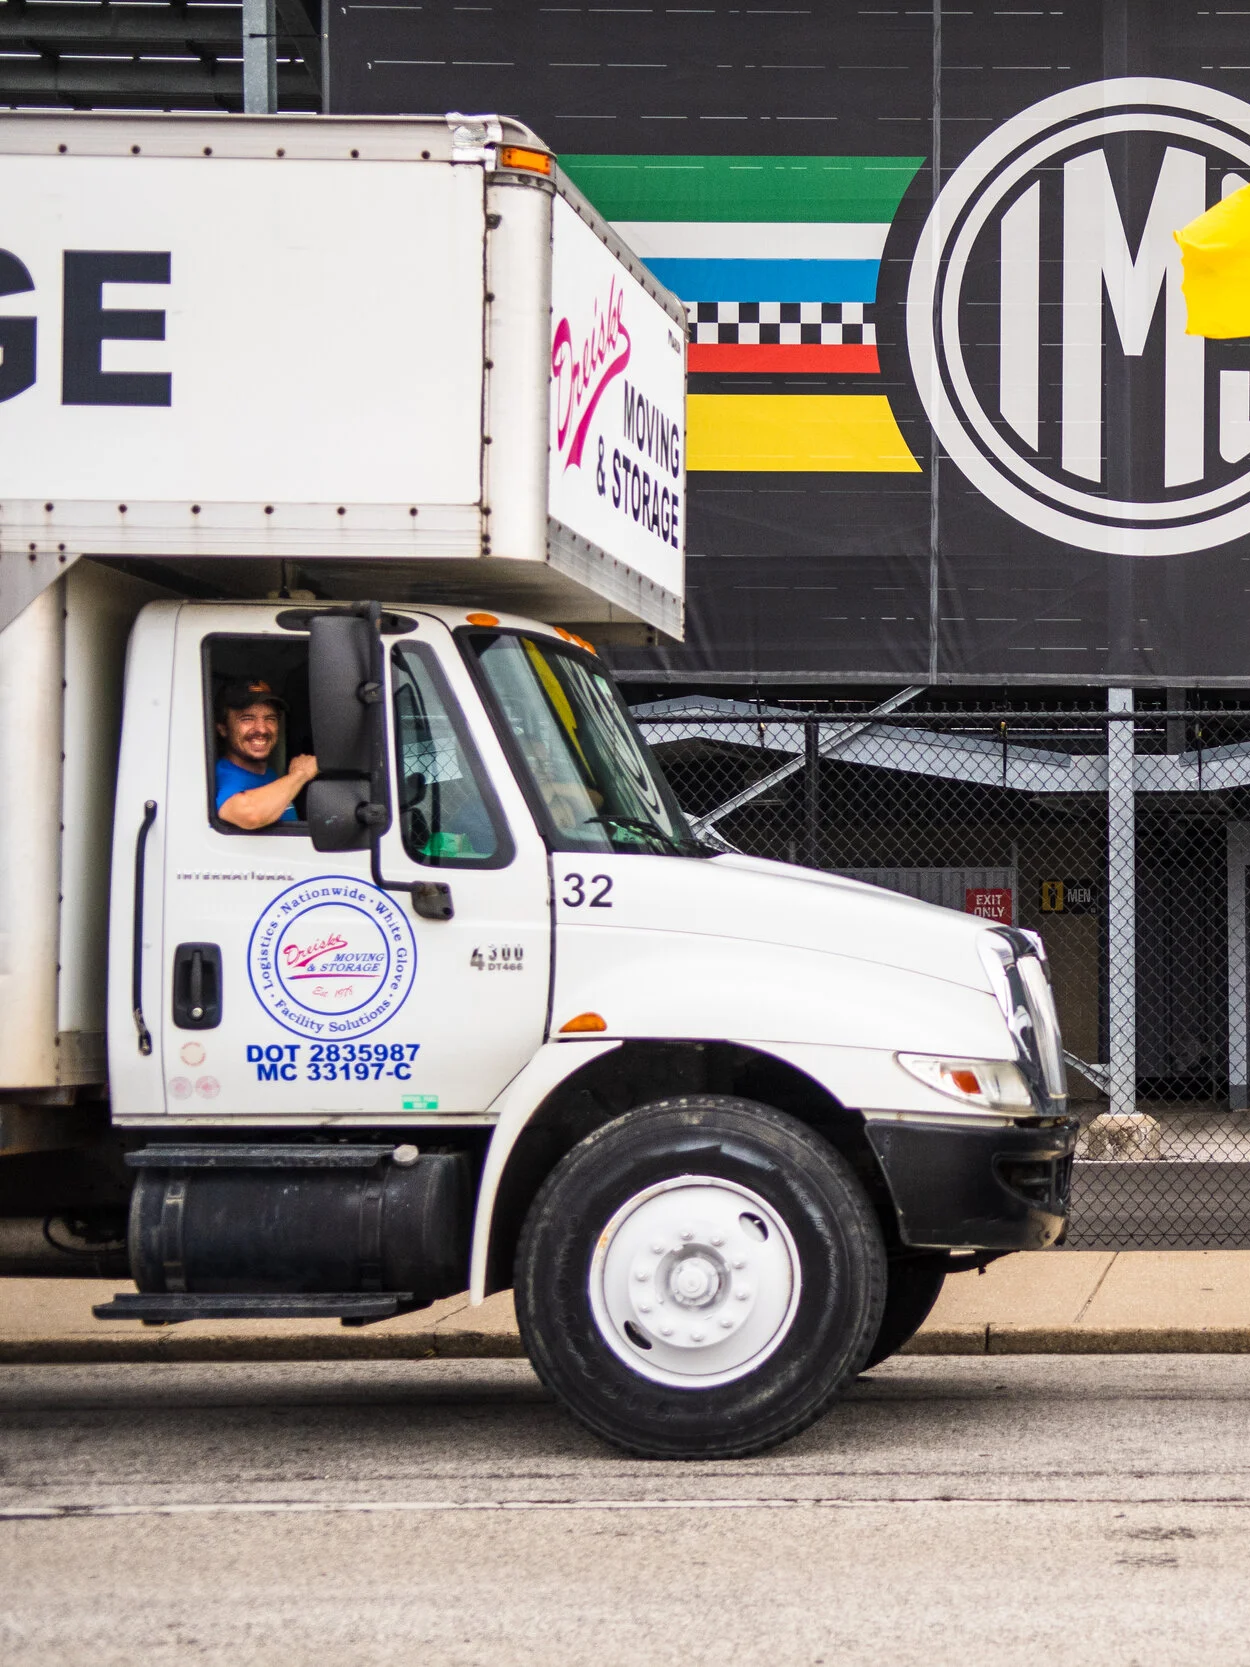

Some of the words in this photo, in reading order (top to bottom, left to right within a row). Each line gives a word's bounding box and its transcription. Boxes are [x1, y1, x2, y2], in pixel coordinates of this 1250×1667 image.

[0, 246, 171, 406] E
[624, 379, 680, 480] MOVING
[596, 434, 607, 497] &
[612, 448, 679, 550] STORAGE
[280, 886, 367, 915] Nationwide
[562, 872, 614, 908] 32
[976, 894, 1003, 906] EXIT
[1067, 888, 1091, 903] MEN
[974, 906, 1005, 918] ONLY
[257, 920, 279, 991] Logistics
[334, 953, 385, 962] MOVING
[375, 901, 403, 942] White
[390, 947, 408, 991] Glove
[307, 963, 316, 972] &
[320, 963, 380, 972] STORAGE
[274, 999, 325, 1033] Facility
[329, 999, 391, 1032] Solutions
[246, 1044, 301, 1062] DOT
[310, 1043, 421, 1063] 2835987
[257, 1063, 298, 1081] MC
[306, 1063, 412, 1081] 33197-C
